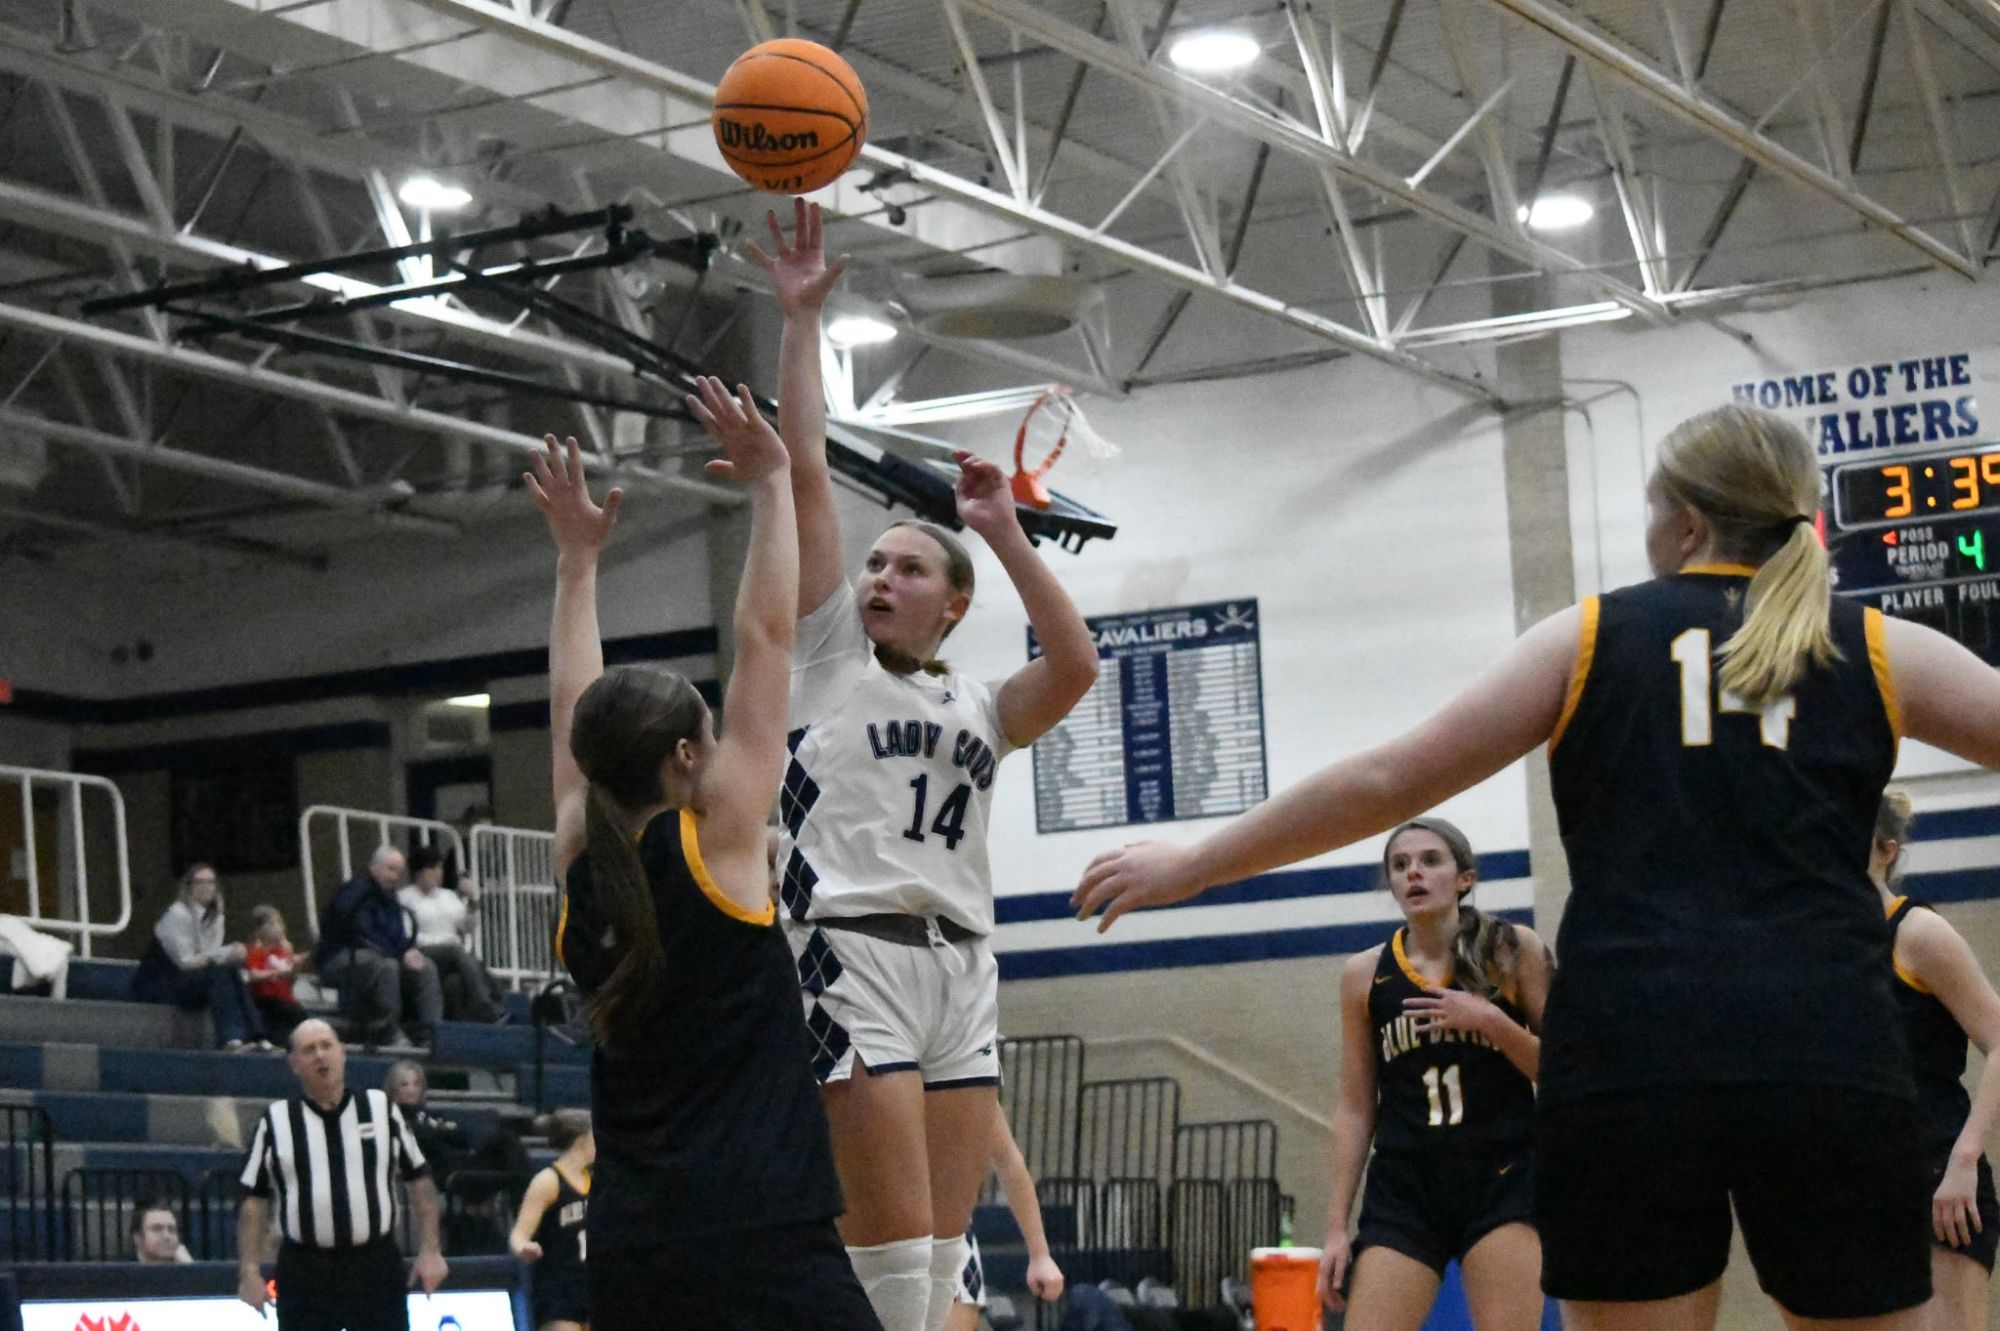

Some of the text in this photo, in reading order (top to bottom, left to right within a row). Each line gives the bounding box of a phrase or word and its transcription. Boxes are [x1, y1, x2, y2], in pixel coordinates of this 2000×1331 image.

[719, 118, 818, 150] Wilson
[1848, 364, 1893, 399] OF
[1900, 353, 1971, 392] THE
[1806, 395, 1979, 455] ALIERS
[1887, 541, 1950, 566] PERIOD
[1957, 529, 1985, 571] 4
[1881, 587, 1945, 611] PLAYER
[866, 719, 943, 760] LADY
[903, 772, 972, 850] 14
[1422, 1064, 1464, 1127] 11
